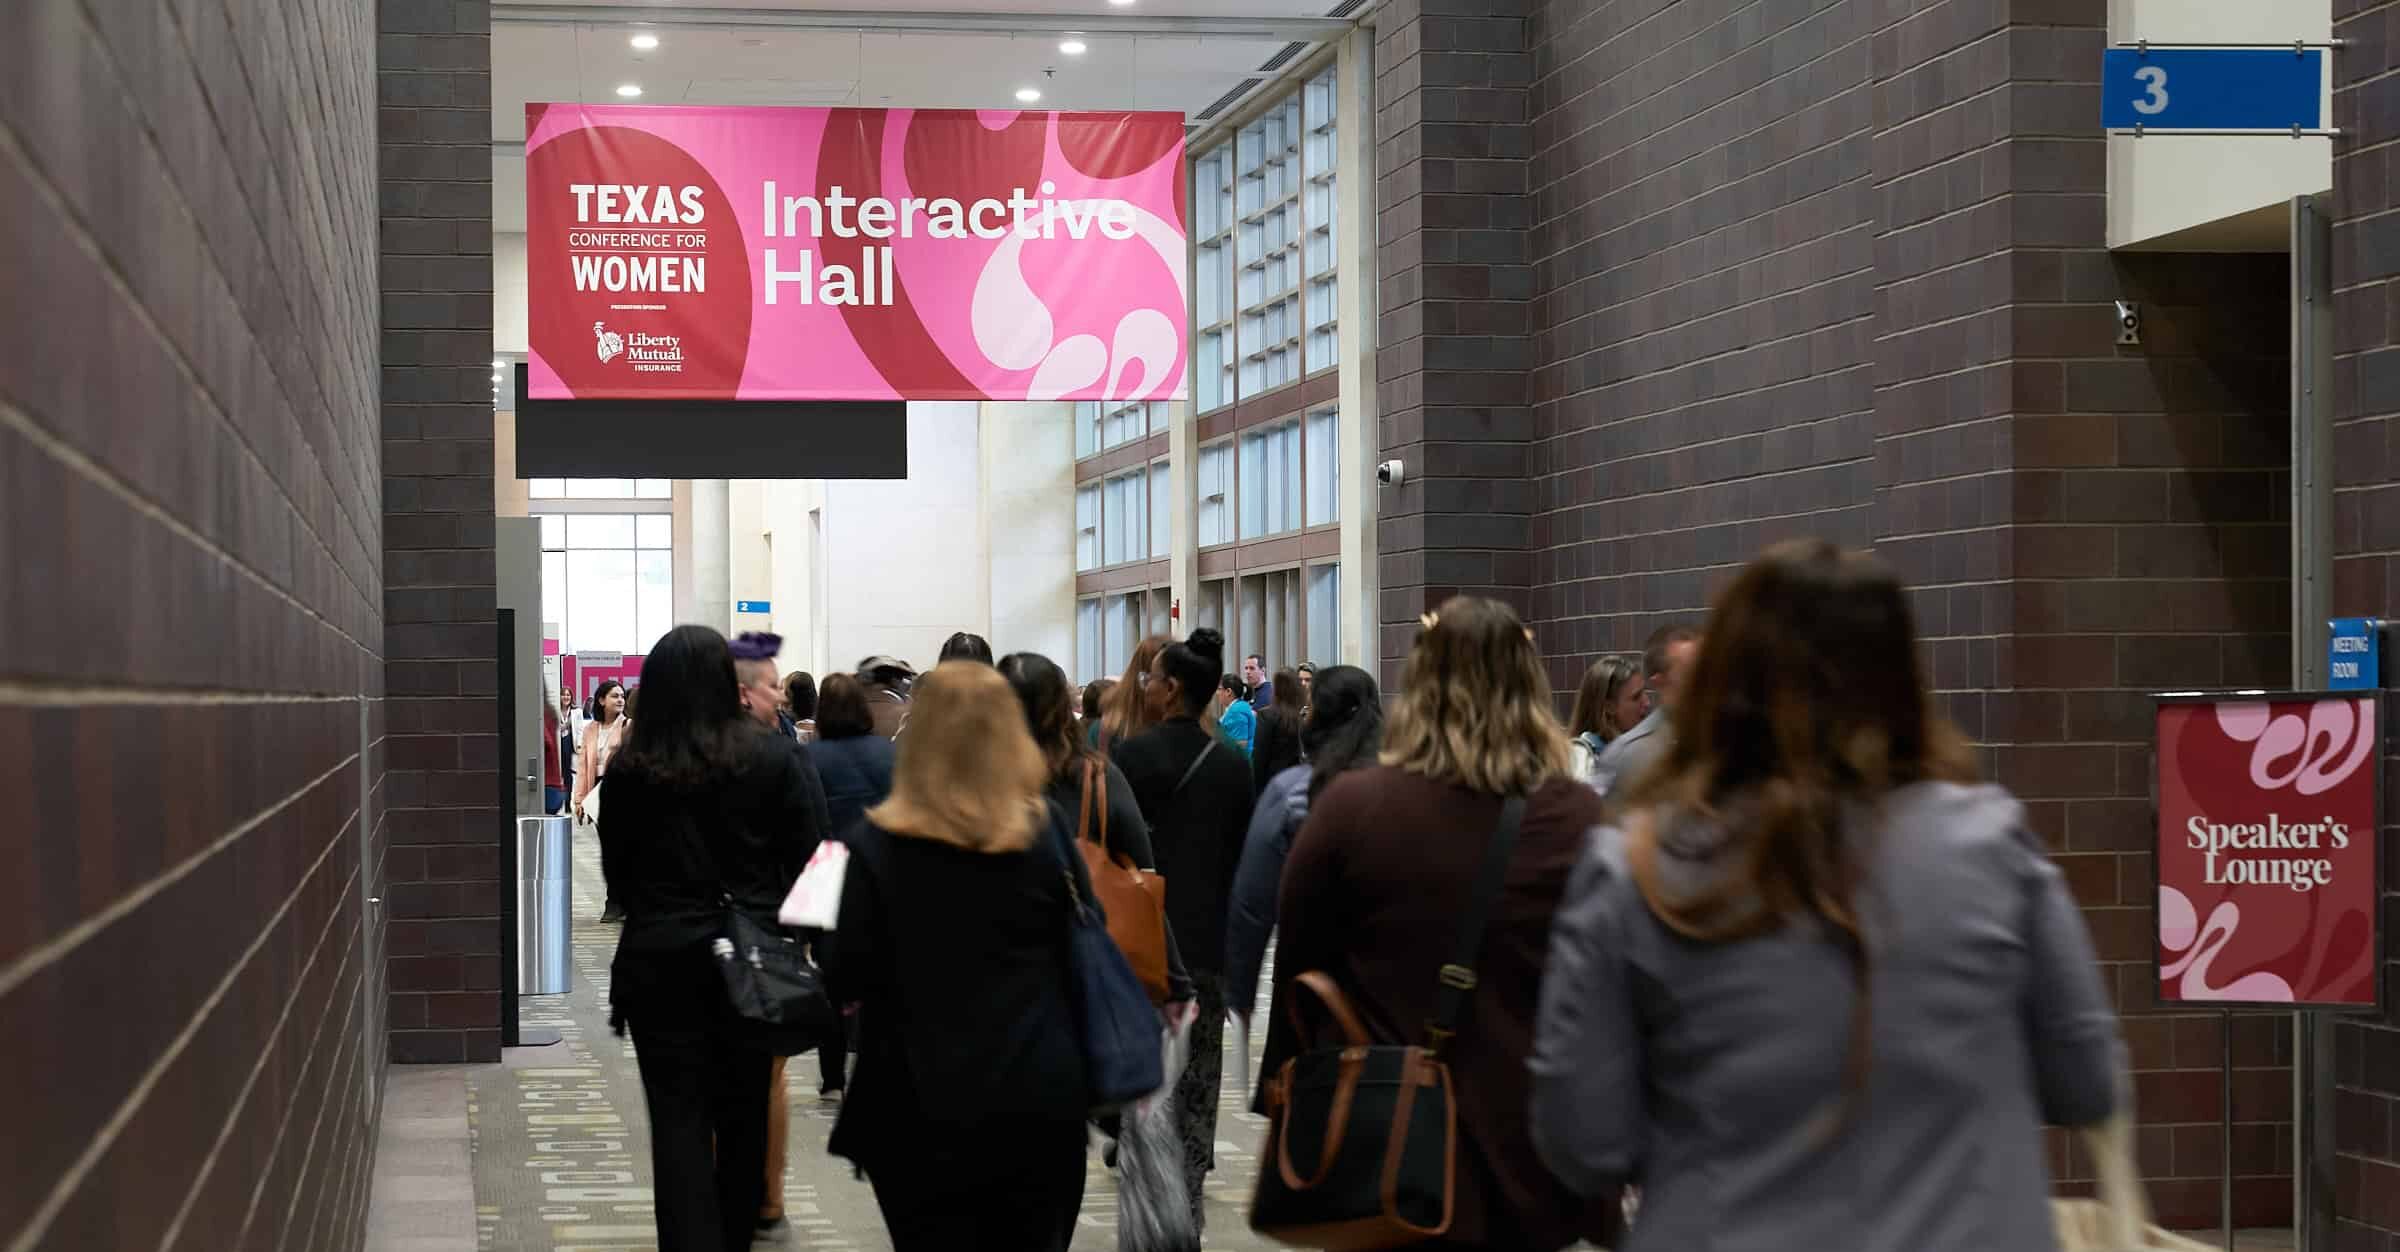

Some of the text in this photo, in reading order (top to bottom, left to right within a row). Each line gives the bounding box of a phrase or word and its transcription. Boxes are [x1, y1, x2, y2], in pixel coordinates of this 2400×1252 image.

[2132, 66, 2169, 114] 3
[570, 184, 705, 224] TEXAS
[763, 181, 1137, 240] Interactive
[569, 233, 706, 248] CONFERENCE FOR
[572, 256, 705, 293] WOMEN
[764, 247, 894, 306] Hall
[627, 333, 680, 351] Liberty
[634, 364, 682, 373] INSURANCE
[740, 602, 749, 611] 2
[2187, 813, 2350, 856] Speaker’s
[2203, 852, 2332, 892] Lounge
